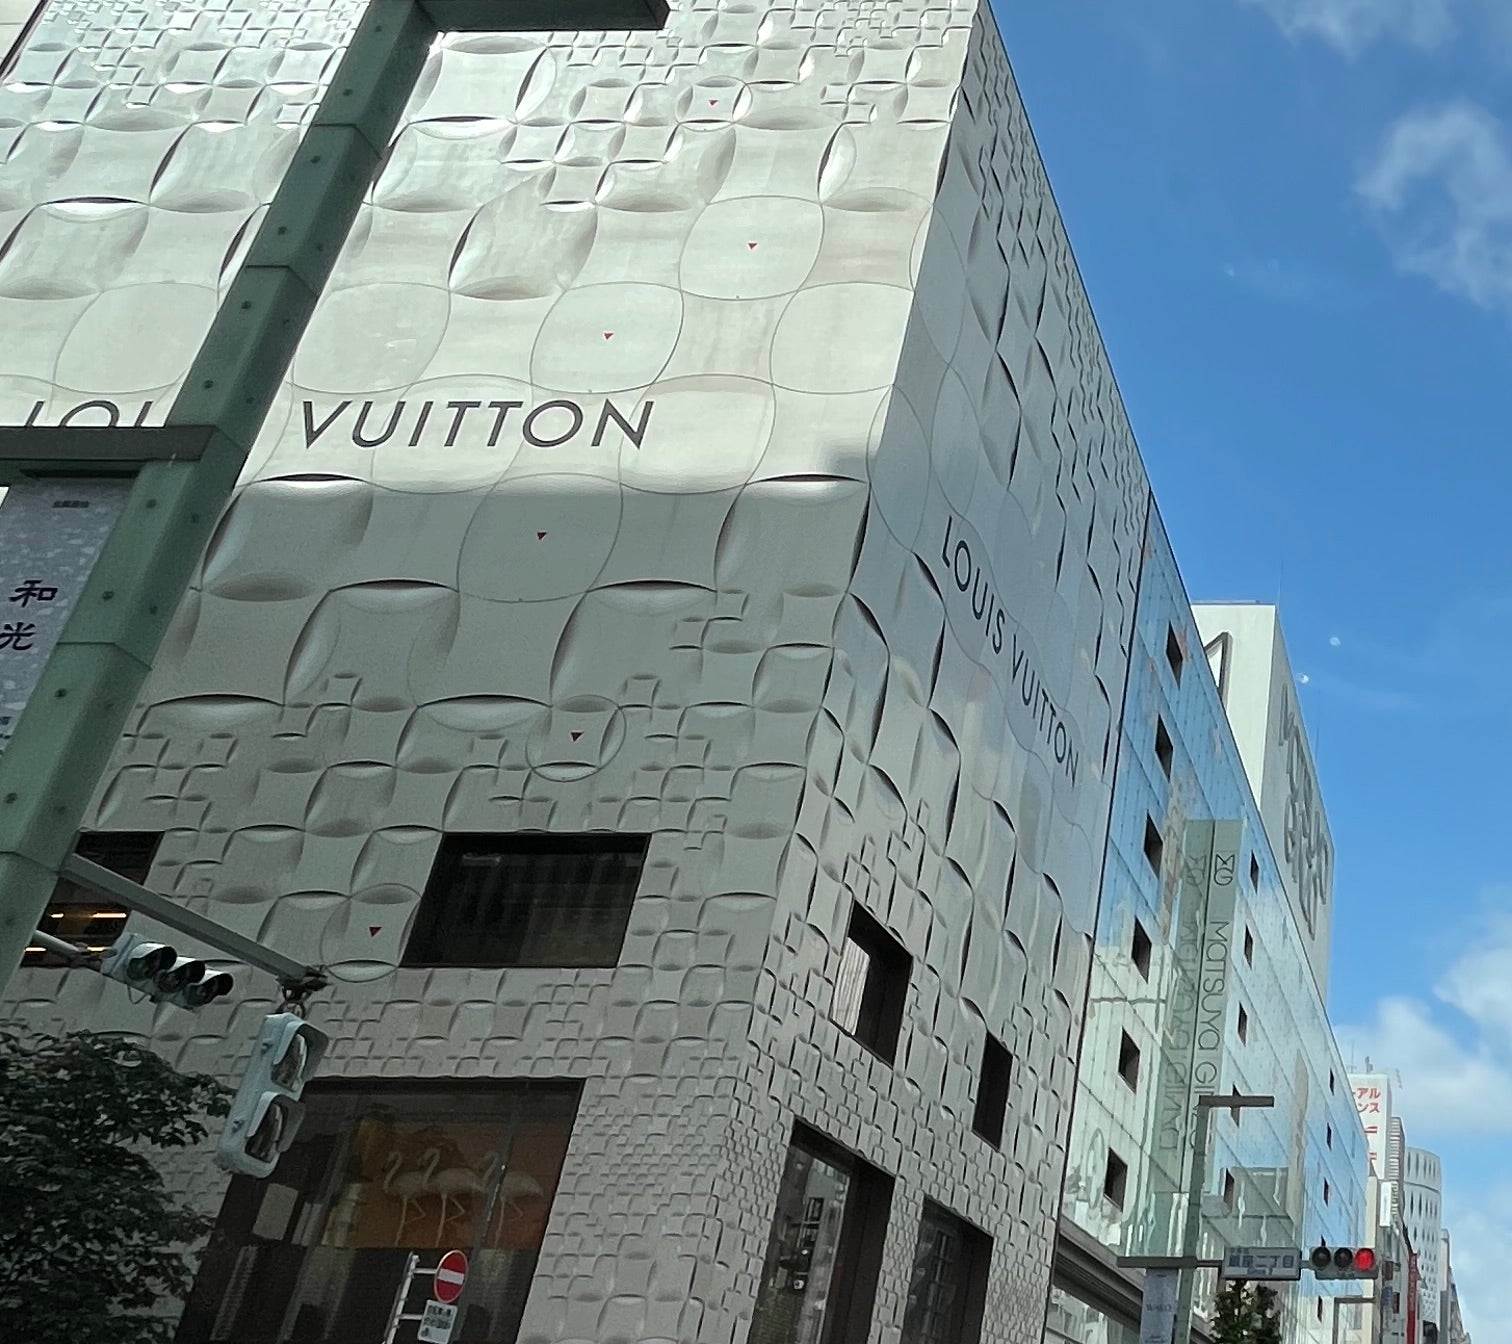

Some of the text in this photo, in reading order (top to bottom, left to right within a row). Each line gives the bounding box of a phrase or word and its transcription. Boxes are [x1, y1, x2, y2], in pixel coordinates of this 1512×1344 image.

[303, 400, 654, 448] VUITTON
[0, 578, 58, 651] 和光
[941, 515, 1079, 789] LOUIS VUITTON
[1353, 1087, 1381, 1099] アル
